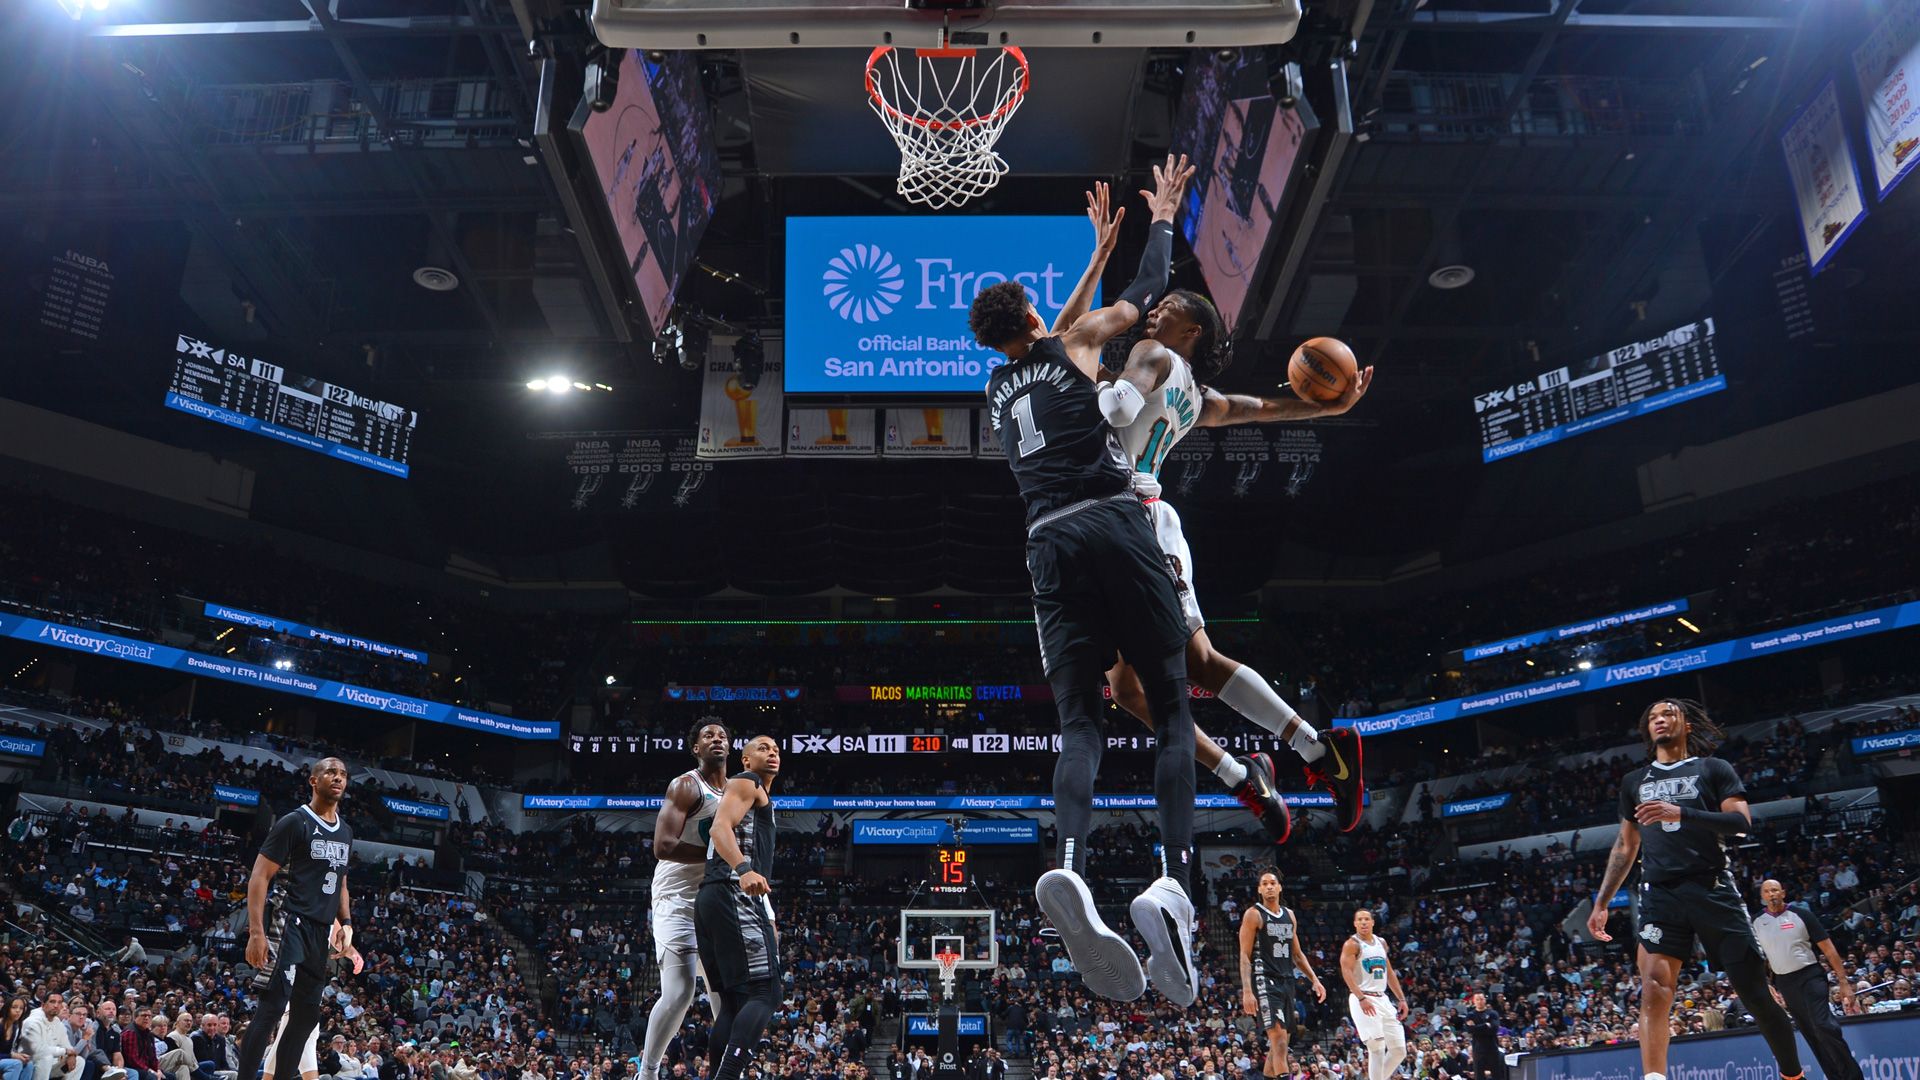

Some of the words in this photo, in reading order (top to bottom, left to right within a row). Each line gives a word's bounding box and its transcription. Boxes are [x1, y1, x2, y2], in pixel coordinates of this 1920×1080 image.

[1886, 83, 1907, 111] 2009
[1889, 99, 1910, 126] 2010
[858, 336, 923, 352] Official
[926, 337, 970, 351] Bank
[1614, 346, 1636, 364] 122
[227, 354, 246, 370] SA
[259, 363, 275, 380] 111
[824, 357, 874, 377] San
[879, 355, 981, 377] Antonio
[1517, 381, 1536, 396] SA
[1545, 370, 1562, 387] 111
[328, 386, 349, 404] 122
[352, 395, 378, 412] MEM
[989, 363, 1077, 432] WEMBANYAMA
[1011, 392, 1046, 458] 1
[631, 440, 661, 448] NBA
[1169, 452, 1213, 461] 2007
[1225, 452, 1270, 461] 2013
[1278, 453, 1321, 463] 2014
[571, 465, 610, 474] 1999
[618, 464, 662, 472] 2003
[670, 463, 714, 471] 2005
[50, 627, 155, 660] VictoryCapital
[188, 657, 231, 674] Brokerage
[238, 667, 257, 680] ETFs
[264, 672, 292, 686] Mutual
[294, 679, 317, 691] Funds
[344, 687, 428, 715] VictoryCapital
[458, 713, 477, 723] Invest
[480, 717, 494, 727] with
[496, 721, 510, 730] your
[512, 724, 531, 733] home
[533, 726, 551, 734] team
[1357, 708, 1435, 733] VictoryCapital
[1462, 695, 1500, 711] Brokerage
[1505, 690, 1523, 702] ETFs
[1528, 683, 1556, 696] Mutual
[1557, 678, 1580, 690] Funds
[1612, 650, 1707, 681] VictoryCapital
[1751, 639, 1778, 651] Invest
[1780, 633, 1801, 645] with
[1802, 628, 1824, 642] your
[1825, 622, 1853, 634] home
[1855, 617, 1880, 628] team
[870, 686, 902, 700] TACOS
[906, 686, 972, 700] MARGARITAS
[977, 686, 1022, 700] CERVEZA
[652, 738, 672, 750] TO
[677, 739, 683, 750] 2
[782, 739, 787, 750] 1
[843, 736, 866, 751] SA
[875, 737, 896, 751] 111
[912, 737, 940, 751] 2:10
[952, 738, 968, 749] 4TH
[979, 736, 1004, 751] 122
[1014, 737, 1048, 751] MEM
[1107, 737, 1126, 748] PF
[1131, 737, 1138, 749] 3
[1235, 737, 1240, 747] 2
[1254, 741, 1260, 750] 5
[1273, 741, 1279, 751] 6
[1639, 775, 1700, 802] SATX
[391, 801, 442, 816] VictoryCapital
[535, 798, 591, 808] VictoryCapital
[607, 798, 645, 808] Brokerage
[833, 799, 856, 807] Invest
[857, 799, 873, 807] with
[874, 800, 892, 808] your
[894, 799, 914, 807] home
[966, 799, 1022, 808] VictoryCapital
[1110, 798, 1136, 806] Mutual
[866, 826, 937, 839] VictoryCapital
[943, 862, 963, 883] 15
[322, 872, 337, 894] 3
[1273, 943, 1289, 958] 24
[939, 1062, 957, 1070] Frost
